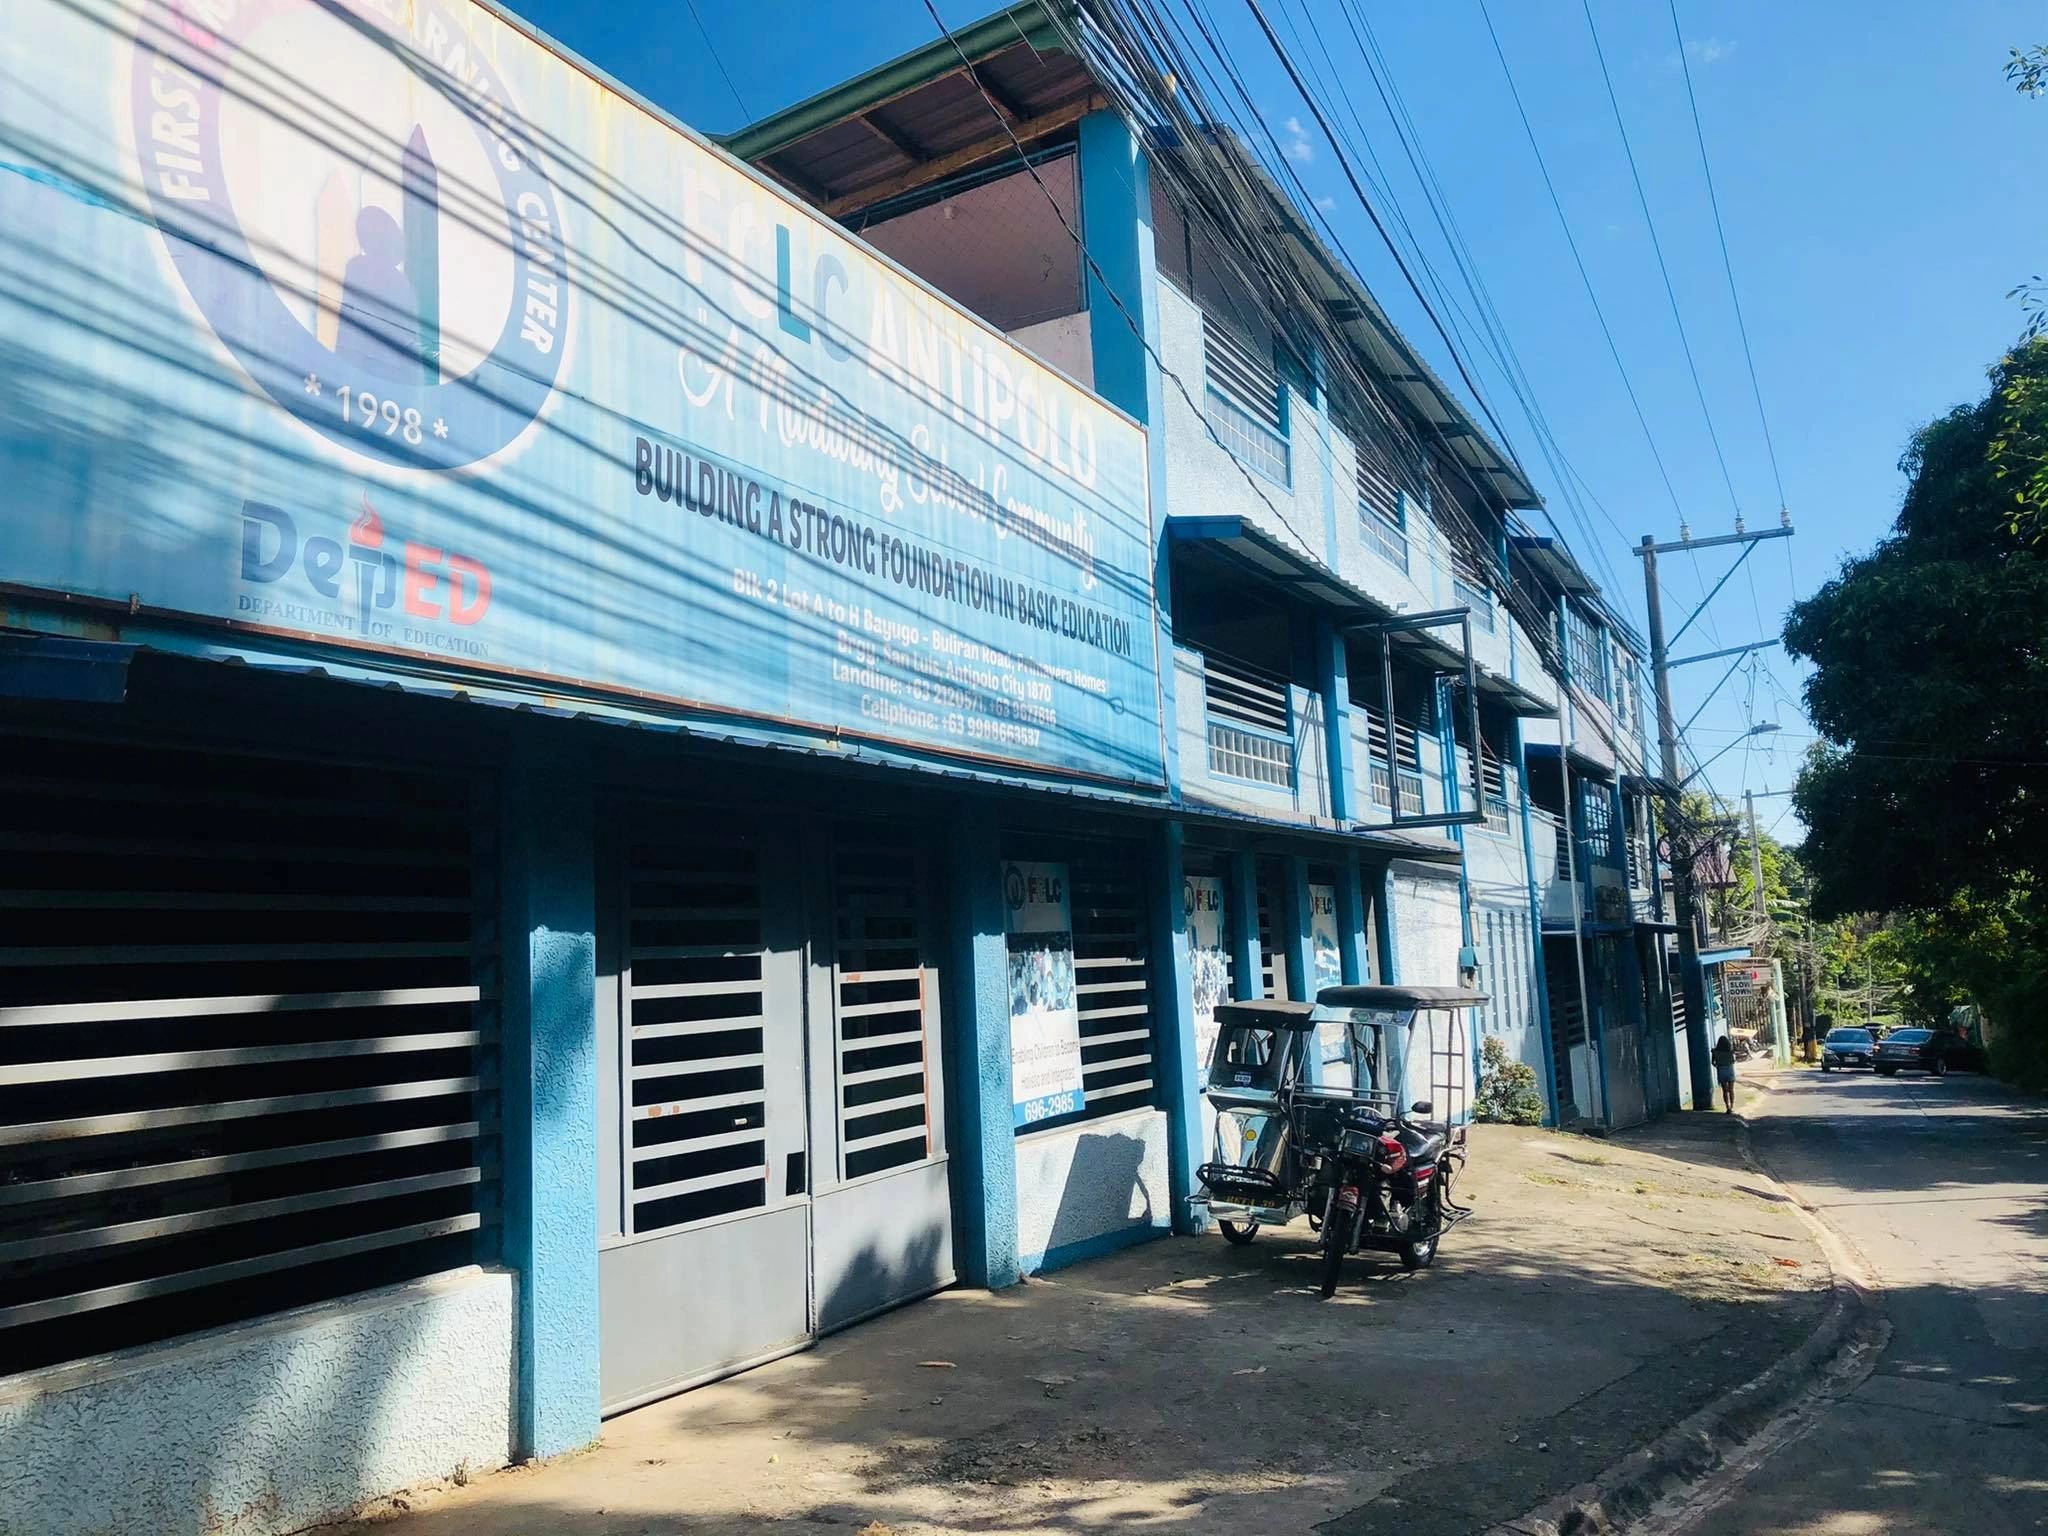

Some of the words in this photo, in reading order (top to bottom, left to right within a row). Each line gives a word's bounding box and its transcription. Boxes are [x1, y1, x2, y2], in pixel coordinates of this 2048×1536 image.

[684, 165, 851, 363] FCLC
[336, 384, 423, 445] 1998
[867, 286, 1098, 488] ANTIPOLO
[635, 436, 762, 536] BUILDING
[767, 490, 785, 544] A
[789, 497, 877, 576] STRONG
[880, 532, 995, 615] FOUNDATION
[998, 575, 1015, 621] IN
[1017, 582, 1059, 634] BASIC
[1061, 598, 1132, 657] EDUCATION
[238, 594, 356, 632] DEPARTMENT
[371, 620, 393, 640] OF
[403, 625, 490, 658] EDUCATION
[733, 567, 763, 599] Blk
[767, 578, 778, 604] 2
[782, 583, 809, 610] Lot
[812, 593, 825, 617] A
[828, 598, 846, 622] to
[849, 603, 860, 628] H
[863, 608, 920, 647] Bayugo
[1073, 668, 1107, 693] Homes
[946, 660, 1000, 691] Antipolo
[1002, 673, 1026, 701] City
[1027, 680, 1053, 703] 1870
[1024, 1092, 1075, 1122] 696-2985
